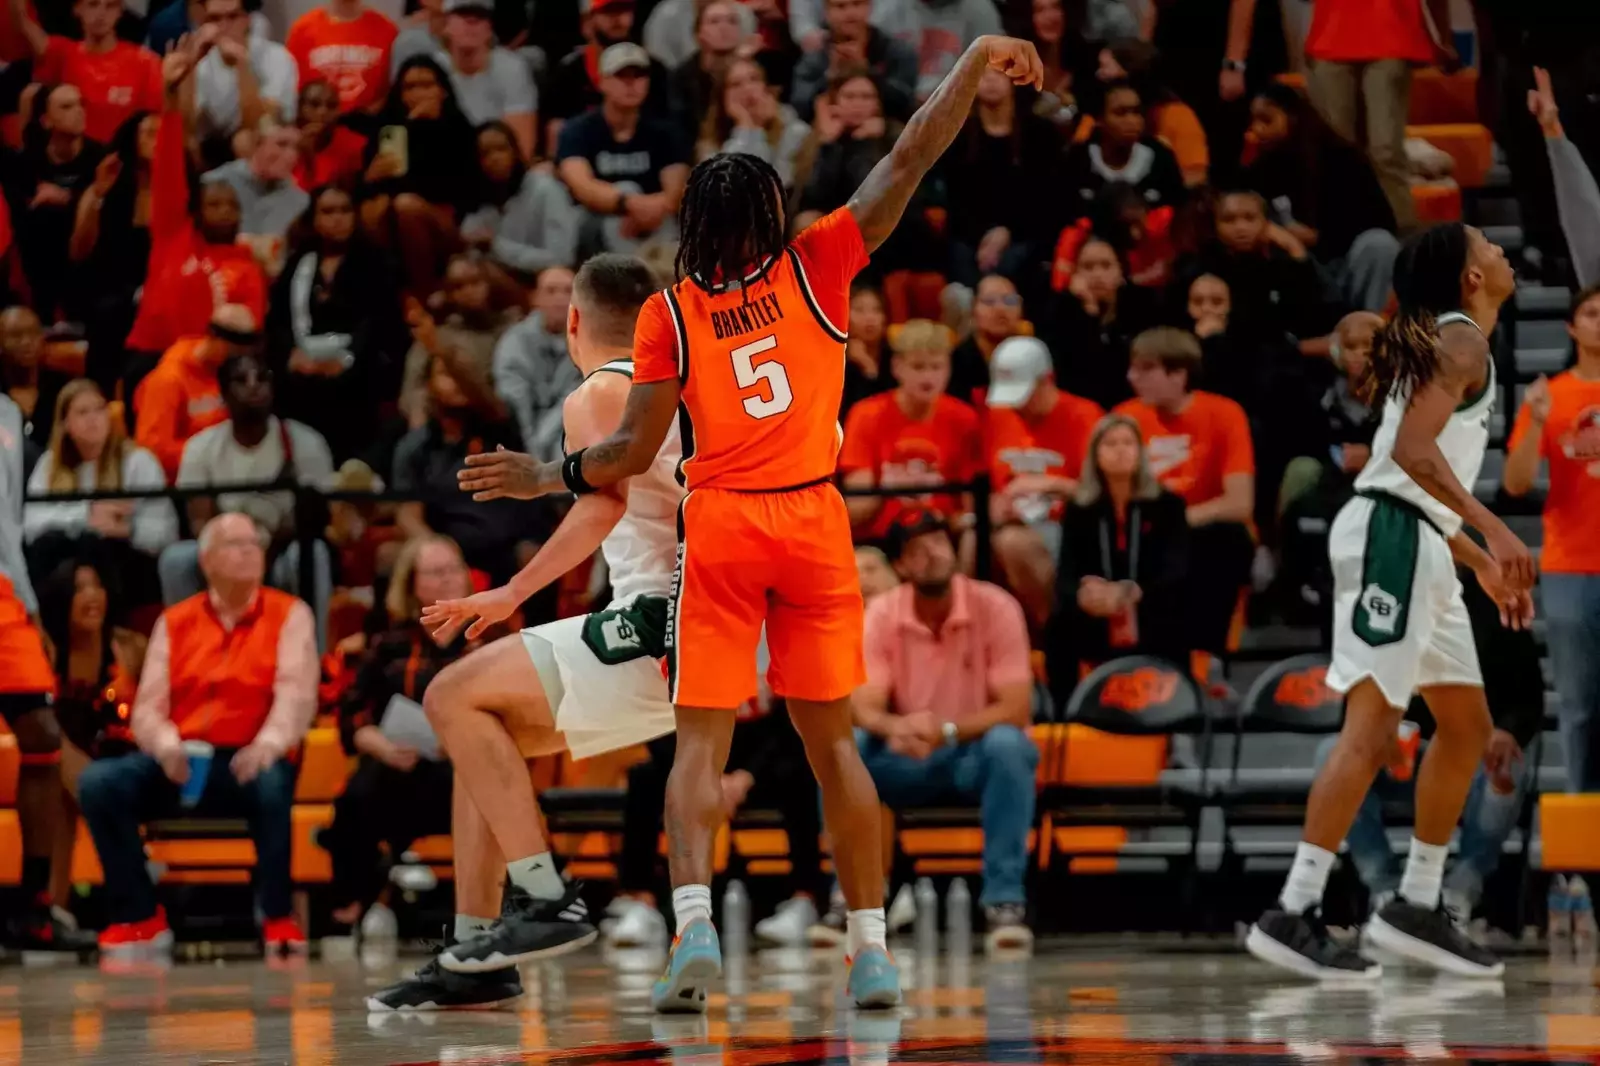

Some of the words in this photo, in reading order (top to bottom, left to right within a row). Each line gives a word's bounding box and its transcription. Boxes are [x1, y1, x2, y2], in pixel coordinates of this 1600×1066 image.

[710, 292, 784, 340] BRANTLEY
[729, 333, 794, 420] 5
[664, 542, 684, 647] COWBOYS
